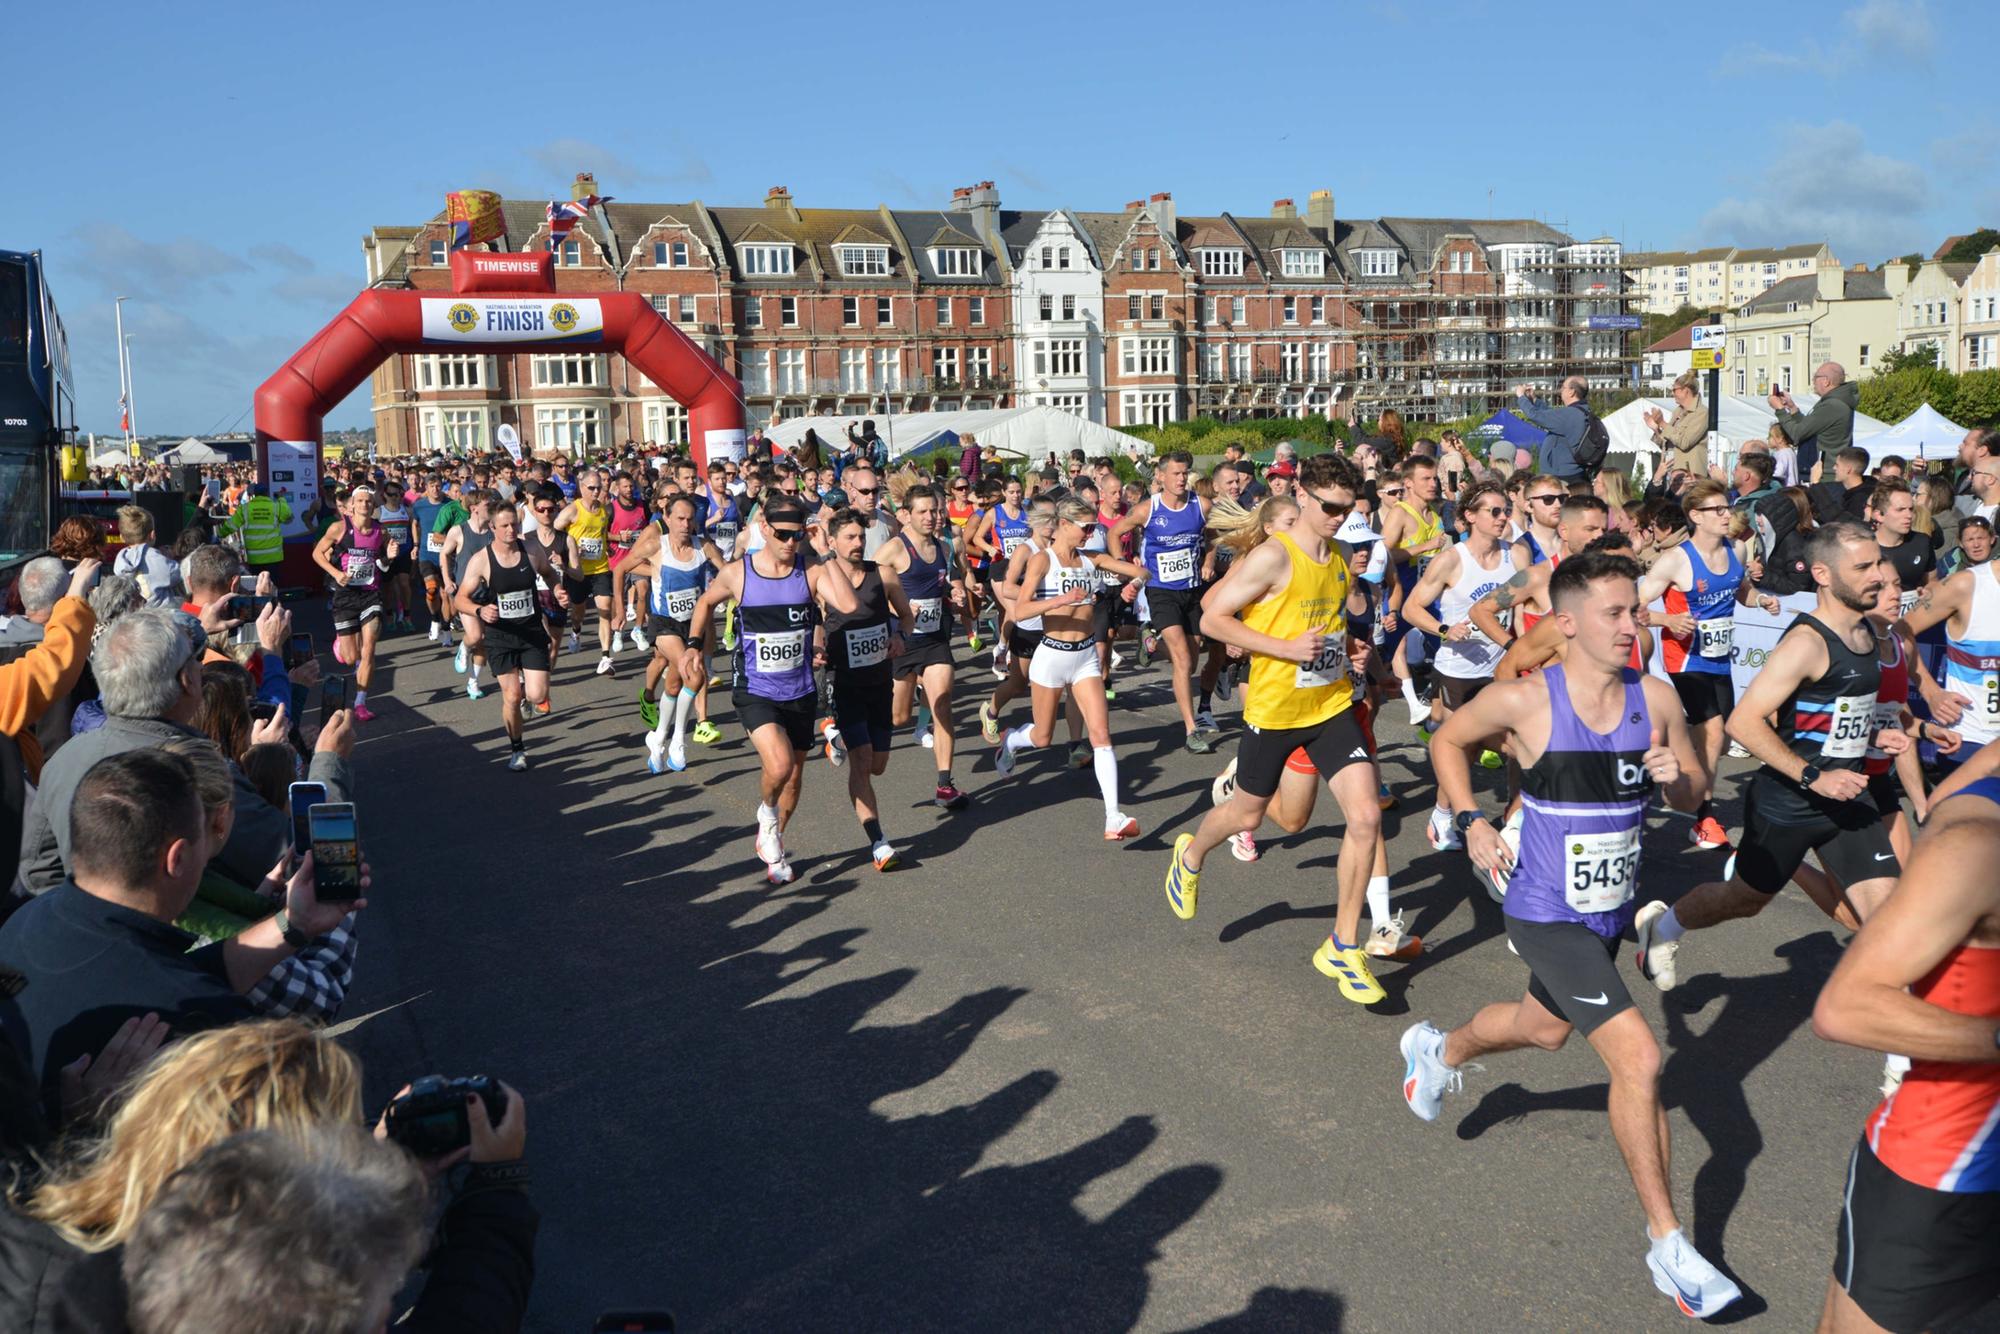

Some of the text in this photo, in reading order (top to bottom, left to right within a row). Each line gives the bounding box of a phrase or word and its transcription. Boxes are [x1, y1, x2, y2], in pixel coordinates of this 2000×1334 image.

[475, 260, 539, 273] TIMEWISE
[487, 311, 544, 331] FINISH
[1695, 329, 1701, 339] P
[4, 418, 28, 426] 10703
[1161, 558, 1190, 573] 7865
[352, 569, 373, 579] 7664
[502, 599, 531, 611] 6801
[671, 598, 699, 613] 685
[789, 608, 809, 621] brt
[760, 642, 802, 661] 6969
[851, 636, 886, 657] 5883
[1044, 639, 1073, 650] PRO
[1618, 759, 1649, 785] br
[1574, 851, 1636, 891] 5435
